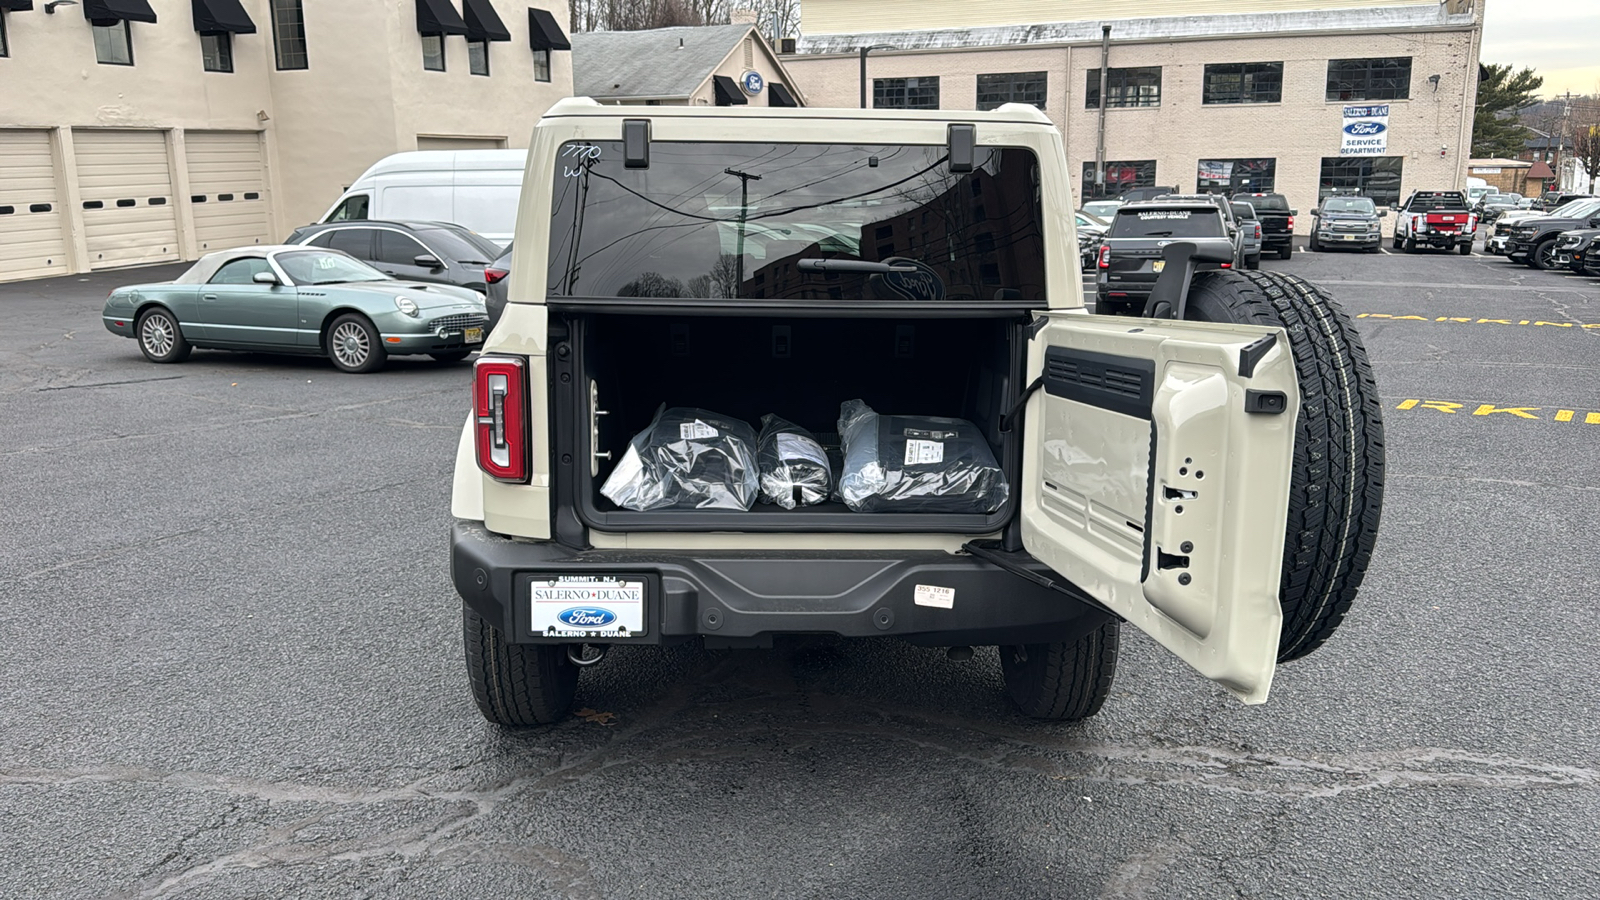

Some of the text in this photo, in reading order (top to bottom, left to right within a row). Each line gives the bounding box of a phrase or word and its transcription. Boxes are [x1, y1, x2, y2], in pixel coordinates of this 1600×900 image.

[1343, 106, 1388, 117] SALERNO DUANE
[1351, 123, 1379, 134] Ford
[562, 144, 602, 159] 7770
[535, 590, 639, 600] SALERNO DUANE
[568, 609, 605, 624] Ford
